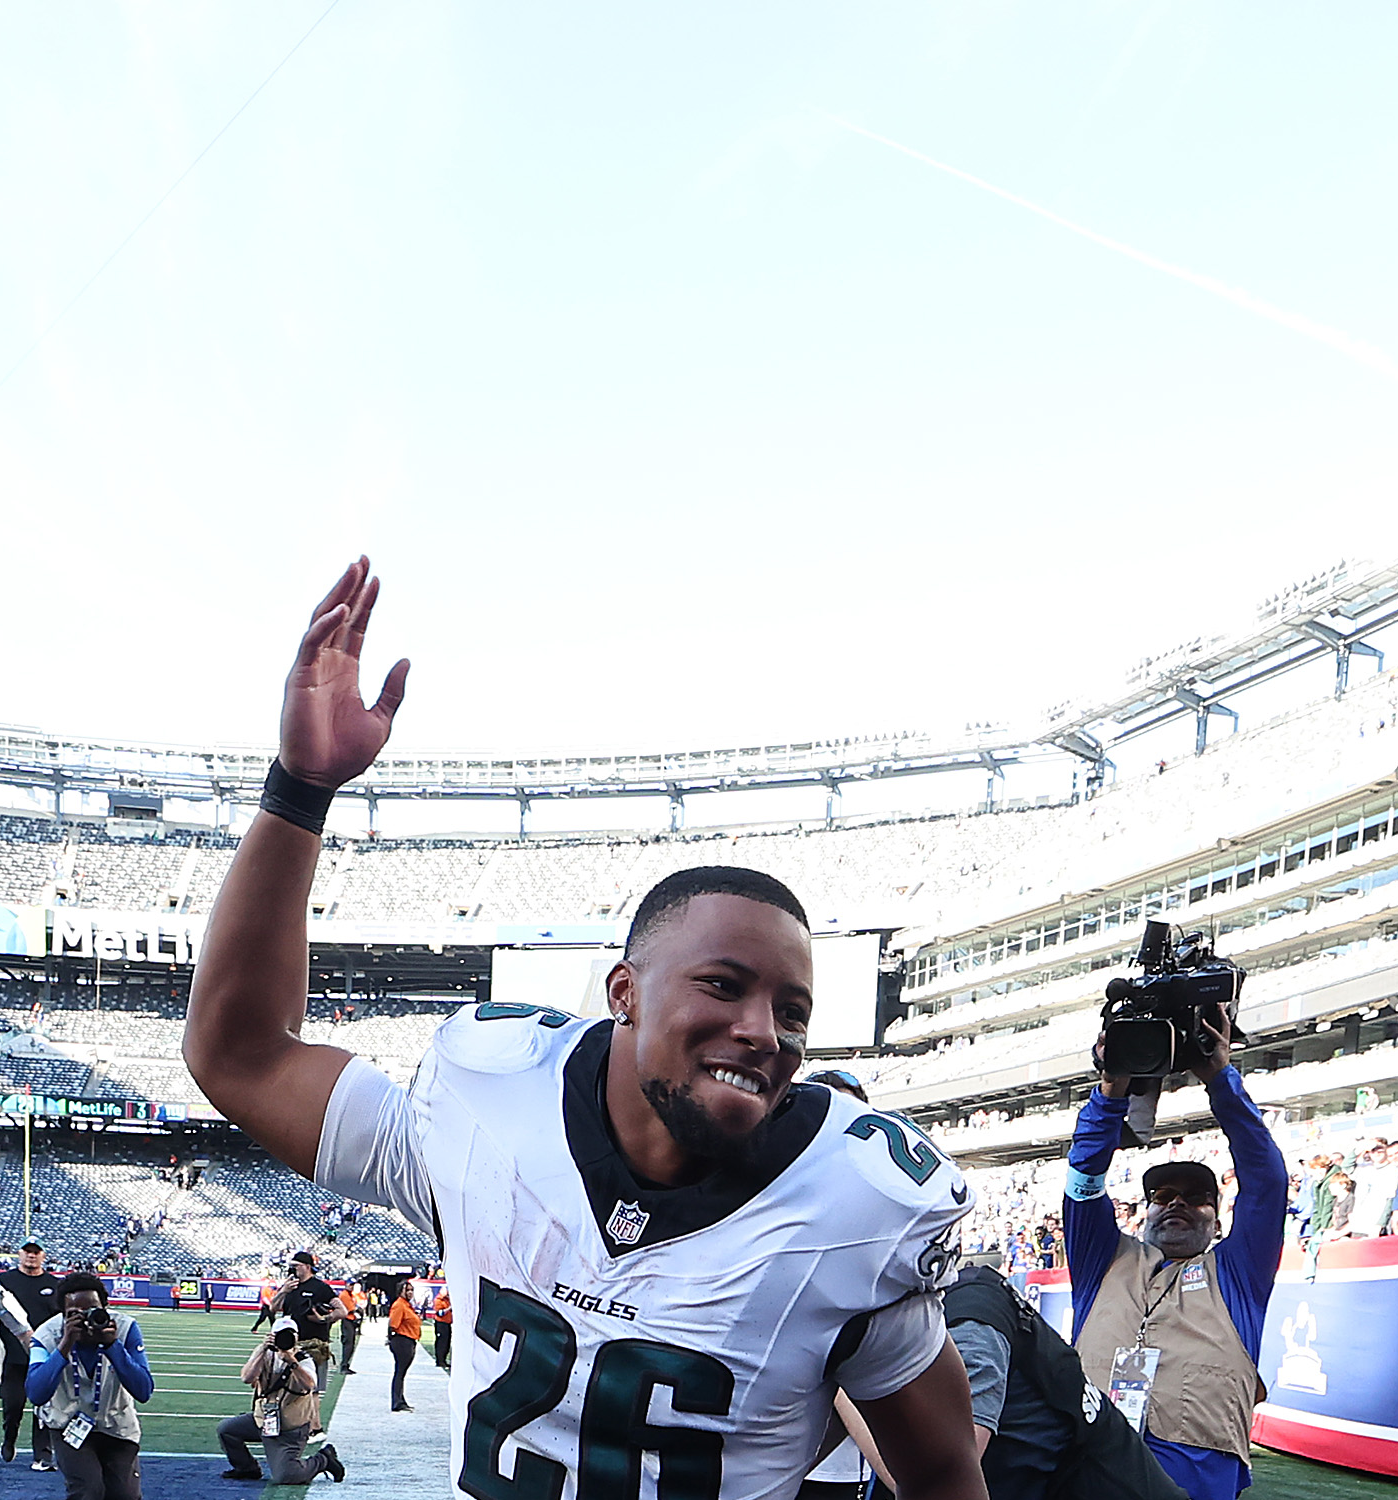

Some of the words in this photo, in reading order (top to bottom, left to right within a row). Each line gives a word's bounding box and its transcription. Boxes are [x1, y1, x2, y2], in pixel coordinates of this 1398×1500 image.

[68, 1100, 122, 1117] MetLife
[136, 1101, 147, 1119] 3
[613, 1220, 638, 1240] NFL
[1184, 1270, 1202, 1280] NFL
[112, 1279, 135, 1291] 100
[180, 1281, 196, 1295] 25
[226, 1286, 260, 1299] GIANTS
[553, 1281, 640, 1322] EAGLES
